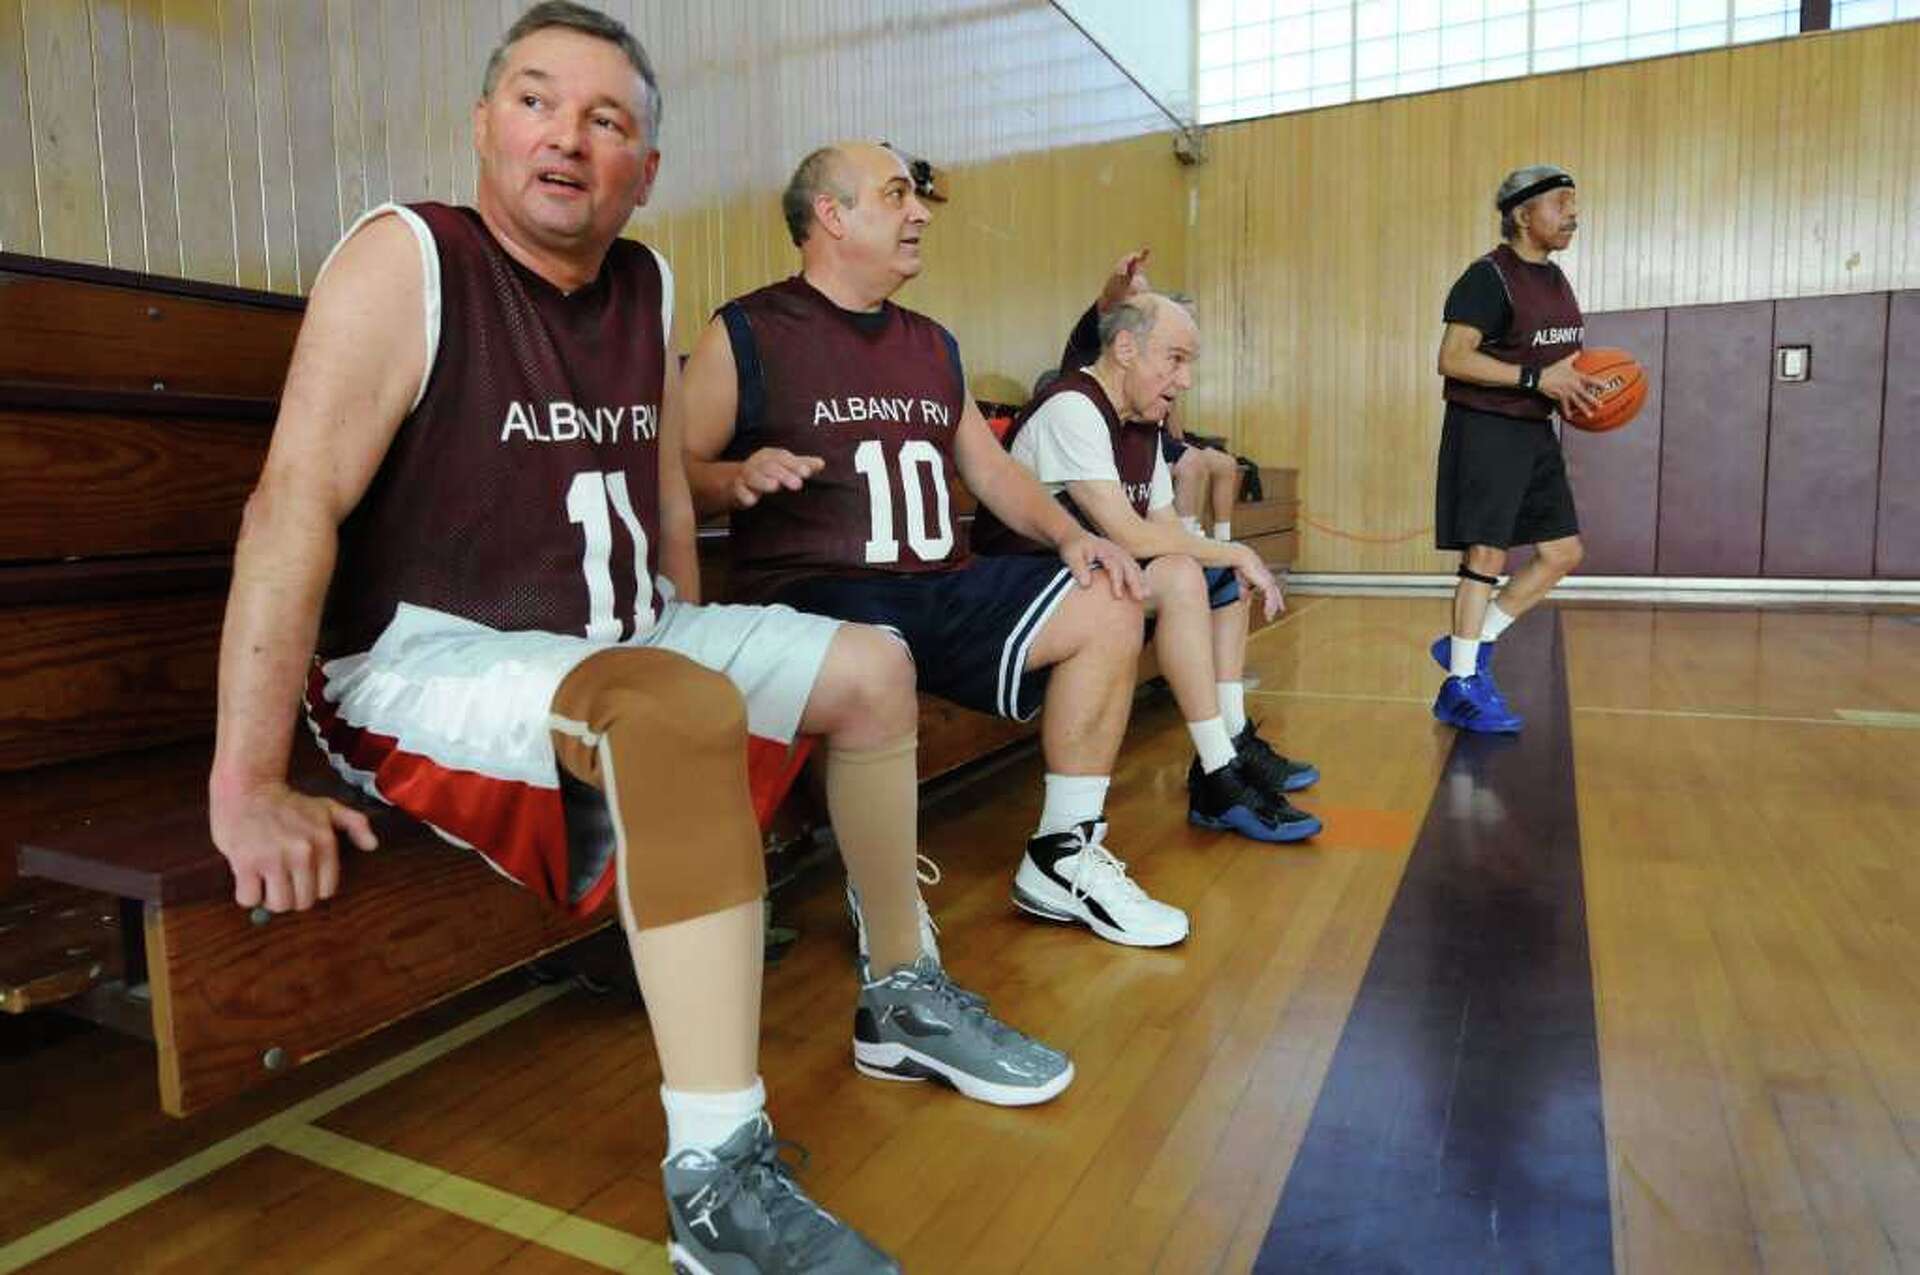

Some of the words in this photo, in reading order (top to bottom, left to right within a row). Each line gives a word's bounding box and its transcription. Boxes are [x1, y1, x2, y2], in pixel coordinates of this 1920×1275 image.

[1531, 327, 1577, 346] ALBANY
[501, 401, 625, 444] ALBNY
[813, 397, 914, 426] ALBANY
[920, 399, 948, 426] RV
[854, 440, 953, 563] 10
[566, 471, 656, 642] 11
